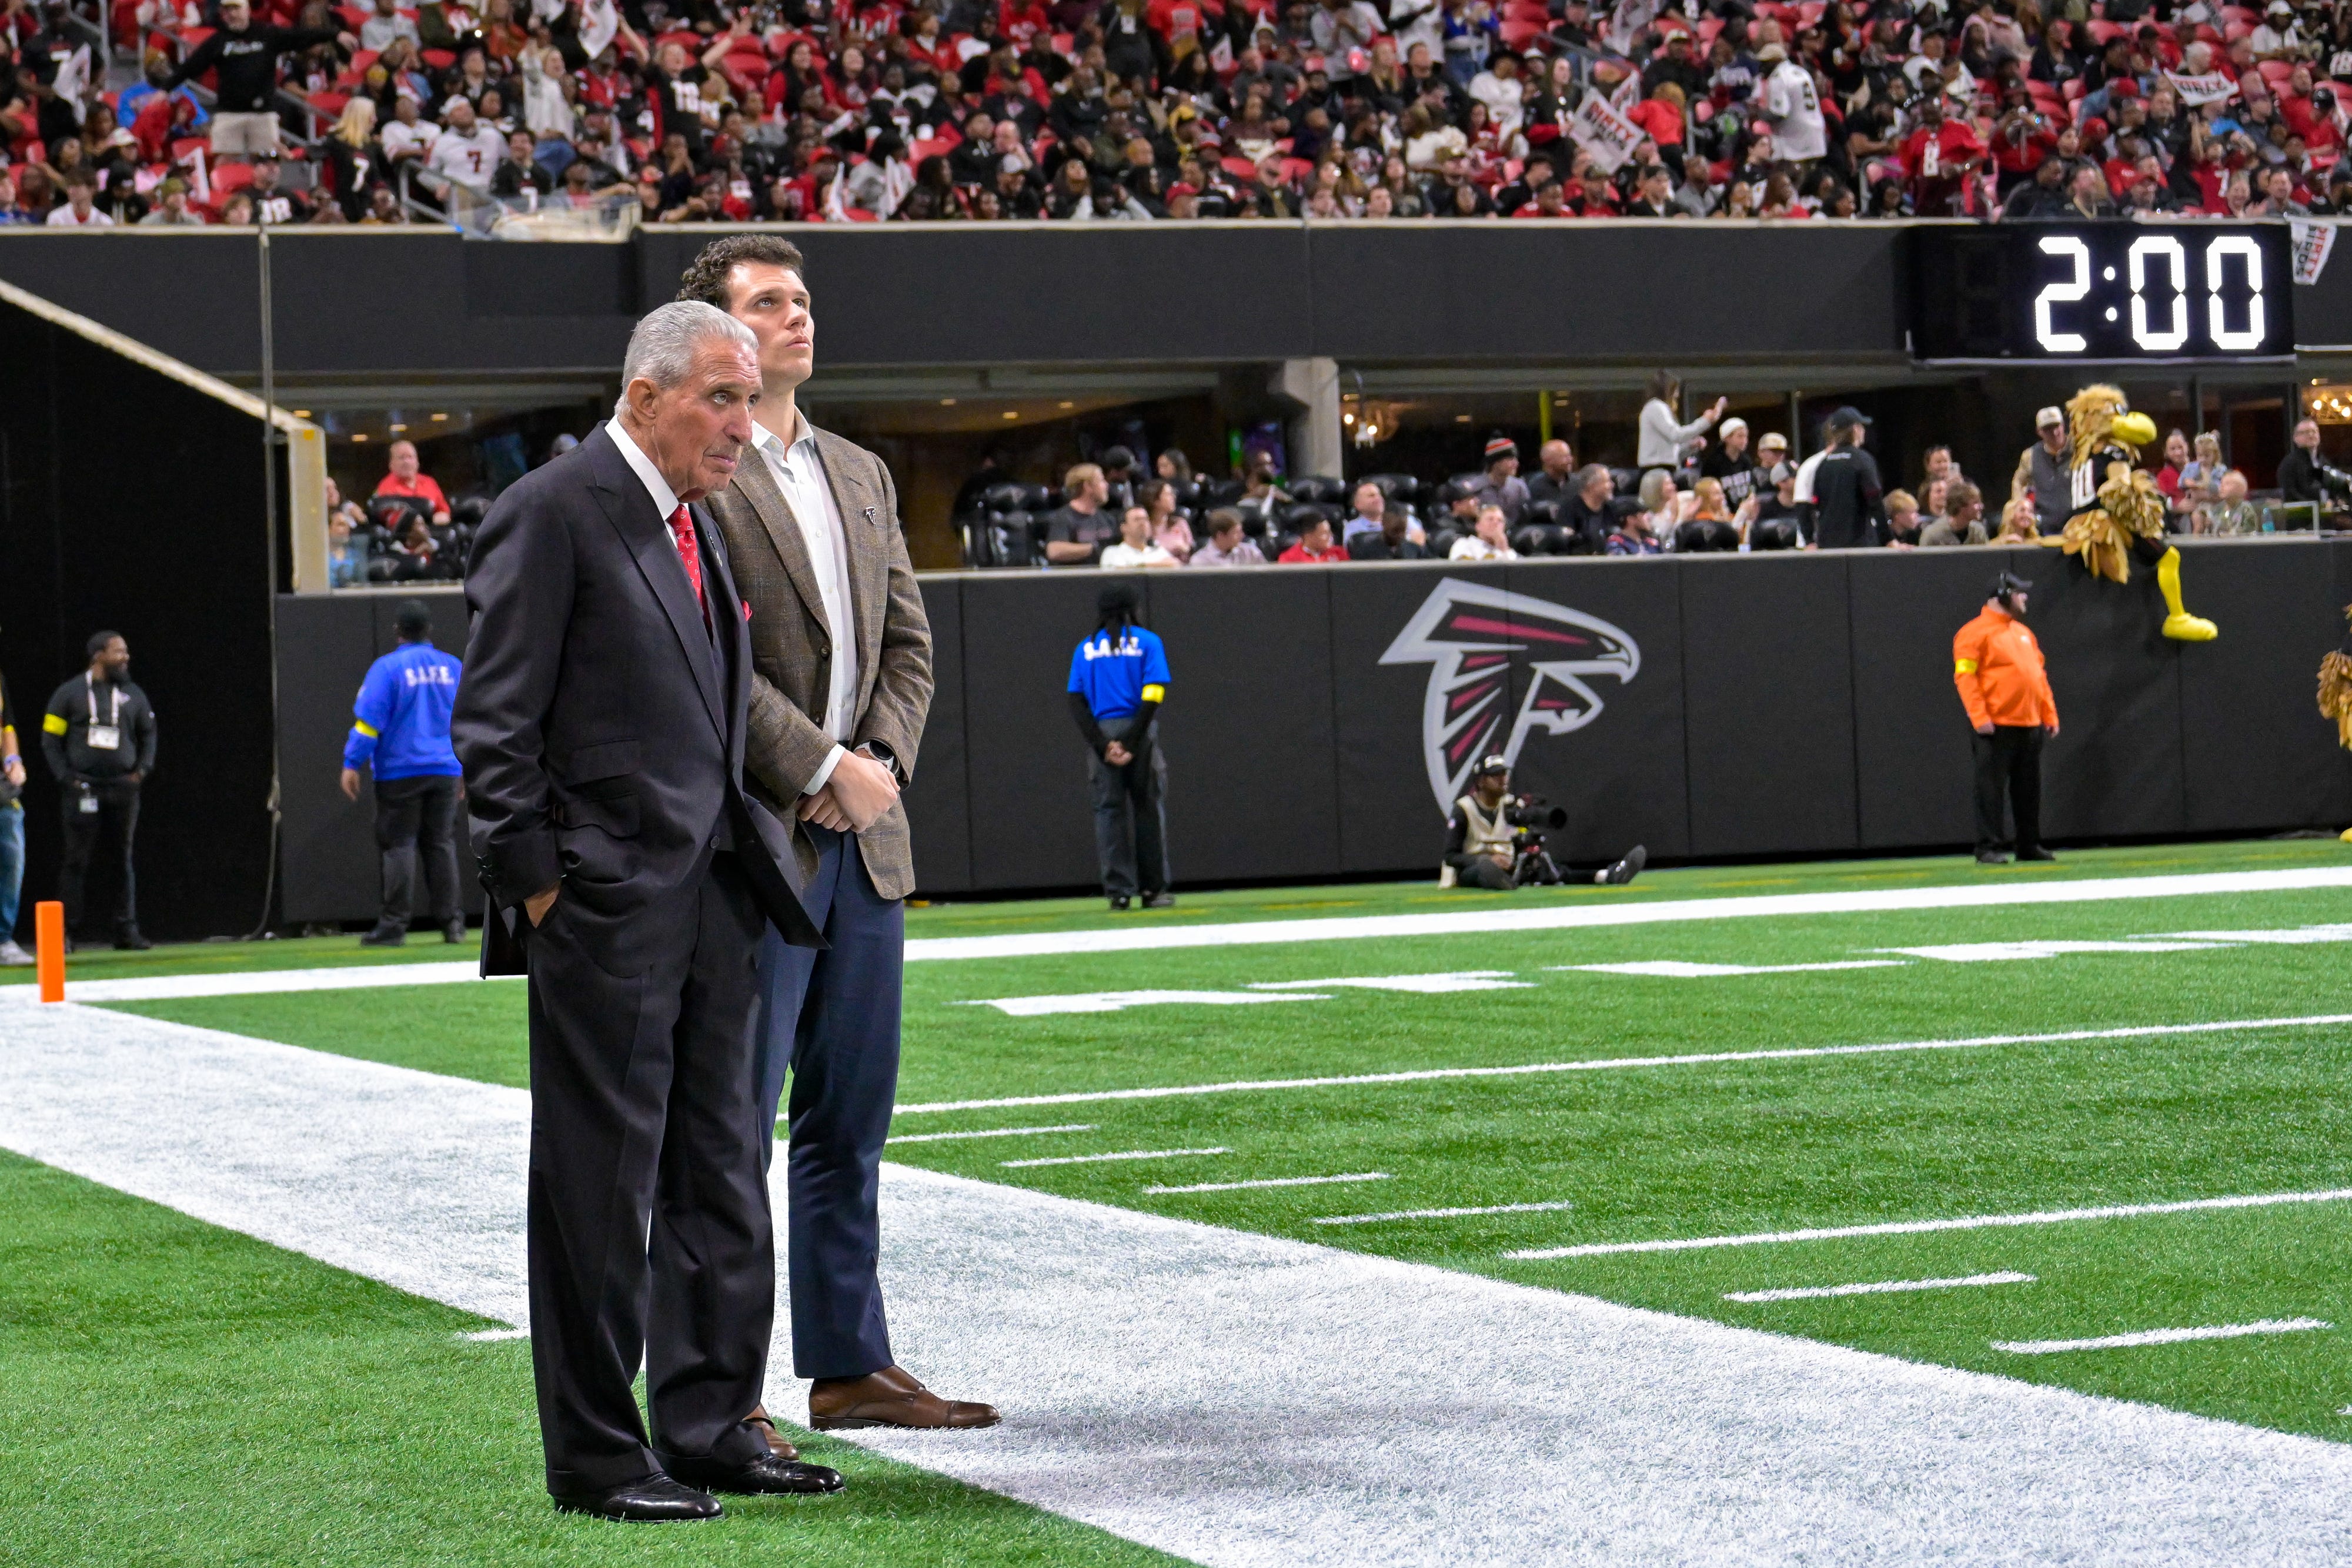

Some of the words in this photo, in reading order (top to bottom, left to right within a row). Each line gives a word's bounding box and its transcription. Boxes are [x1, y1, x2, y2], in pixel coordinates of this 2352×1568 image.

[352, 156, 370, 193] 7
[468, 151, 481, 173] 7
[2035, 236, 2264, 351] 2:00
